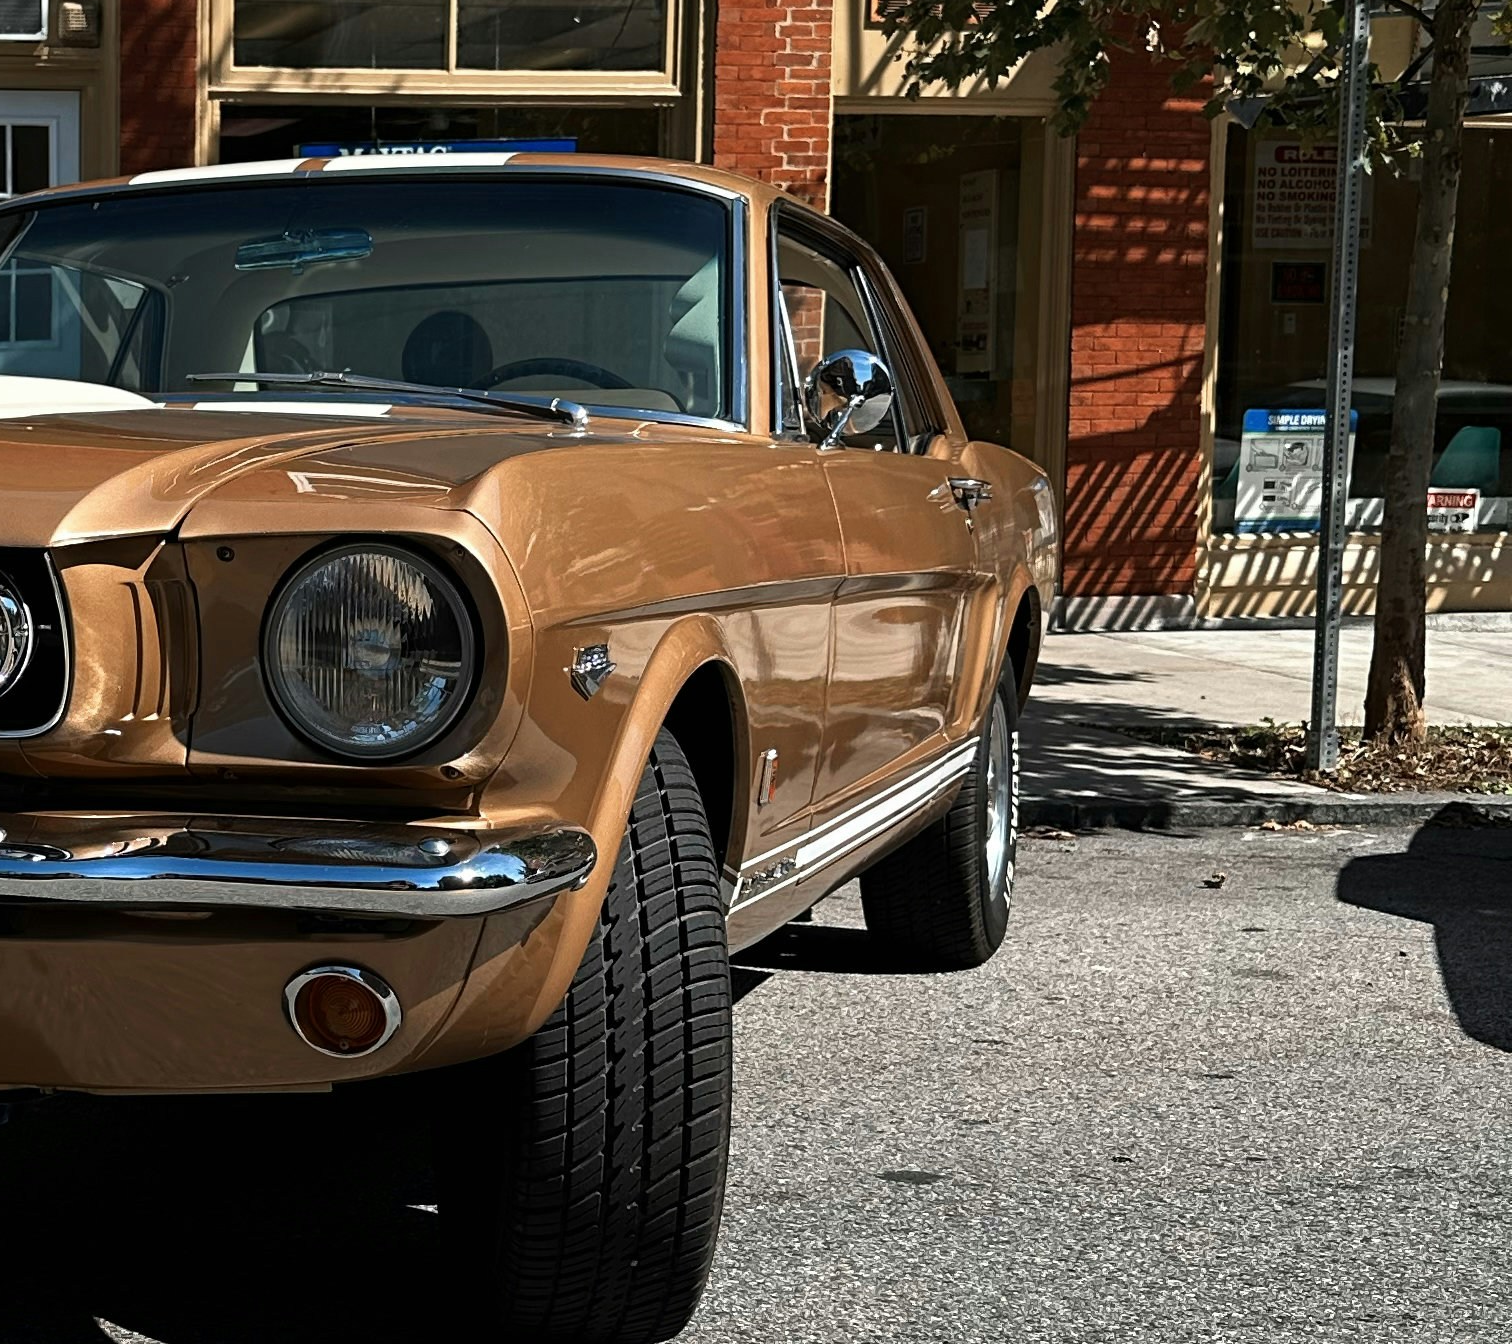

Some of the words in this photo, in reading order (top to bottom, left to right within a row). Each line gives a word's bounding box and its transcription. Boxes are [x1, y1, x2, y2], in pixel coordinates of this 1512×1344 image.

[1283, 149, 1338, 161] RULE
[1257, 167, 1277, 177] NO
[1280, 167, 1338, 177] LOITERIN
[1257, 179, 1276, 189] NO
[1256, 191, 1275, 201] NO
[1300, 414, 1326, 426] DRYIN
[1010, 731, 1019, 846] RADIAL
